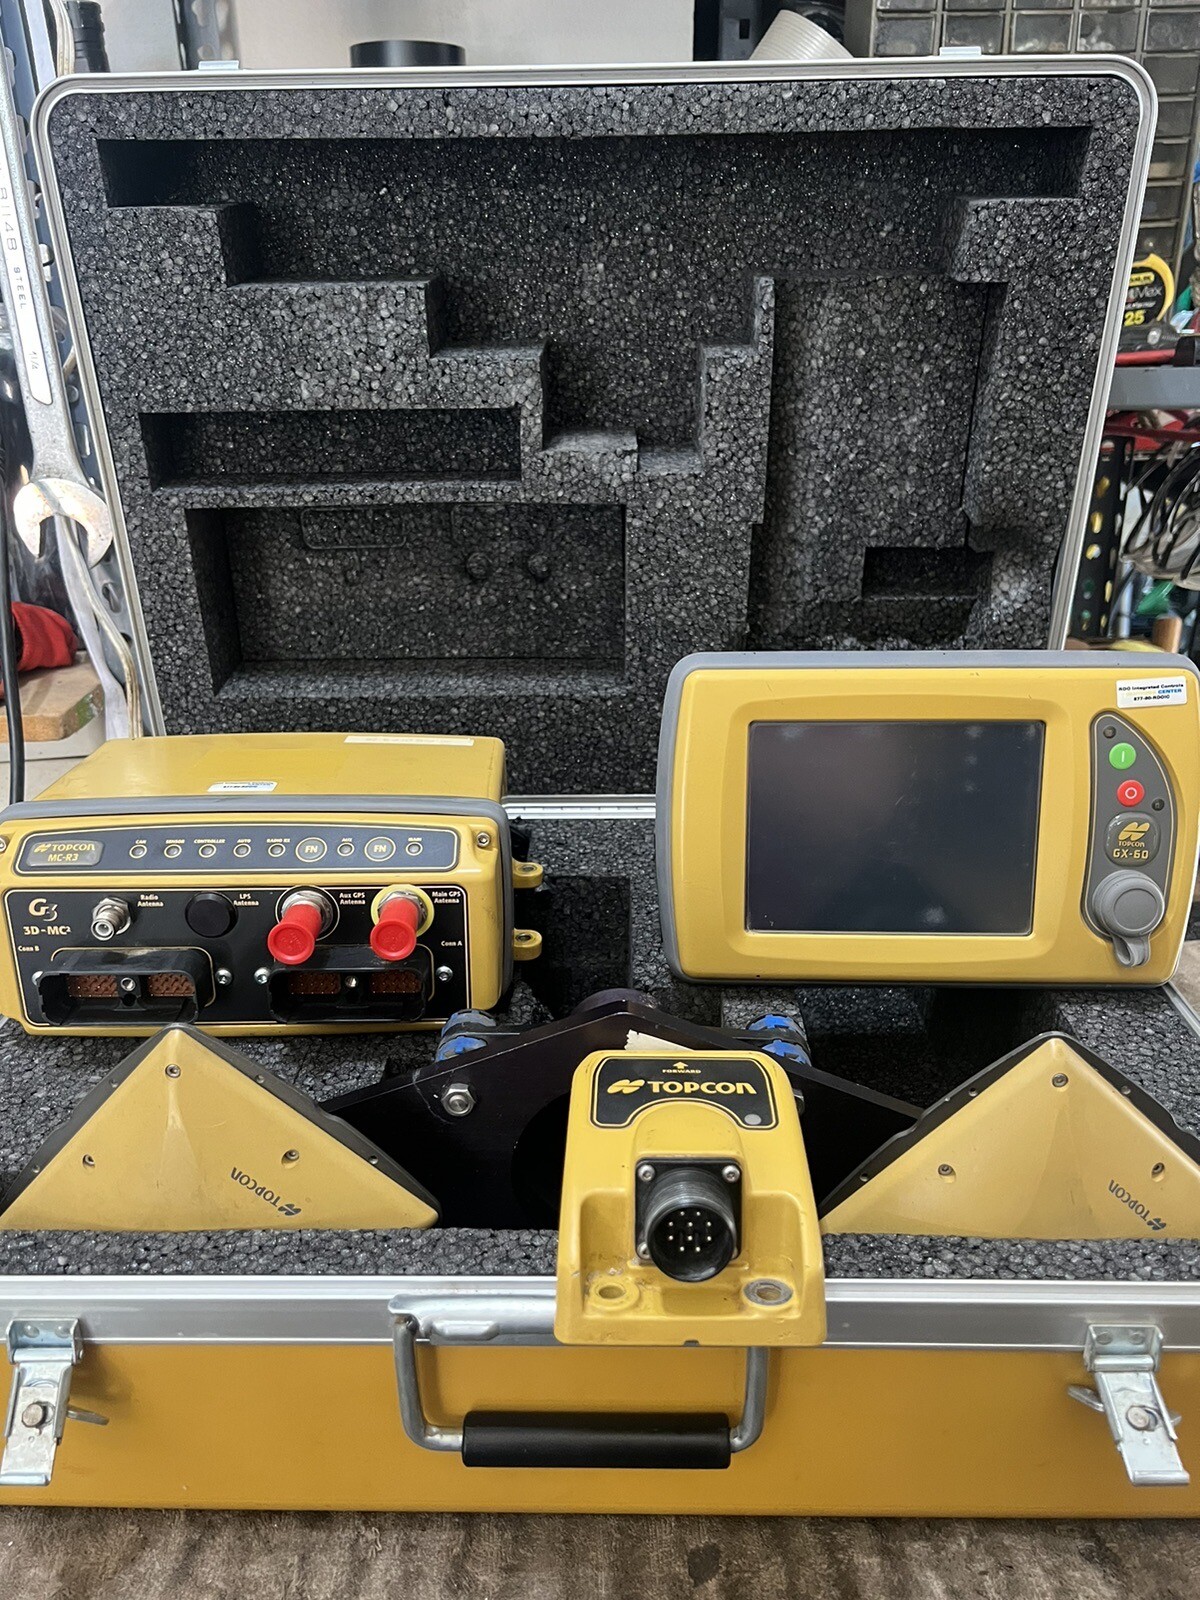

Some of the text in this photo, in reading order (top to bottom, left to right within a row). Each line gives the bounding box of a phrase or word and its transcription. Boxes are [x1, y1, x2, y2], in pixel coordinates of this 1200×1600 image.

[13, 267, 27, 309] STEEL
[1123, 309, 1146, 327] 25
[52, 843, 95, 852] TOPCON
[304, 845, 318, 853] FN
[373, 844, 387, 853] FN
[1113, 848, 1149, 859] GX-60
[47, 853, 79, 862] MC-R3
[647, 1081, 757, 1095] TOPCON
[230, 1166, 281, 1207] TOPCON
[1108, 1179, 1150, 1221] TOPCON
